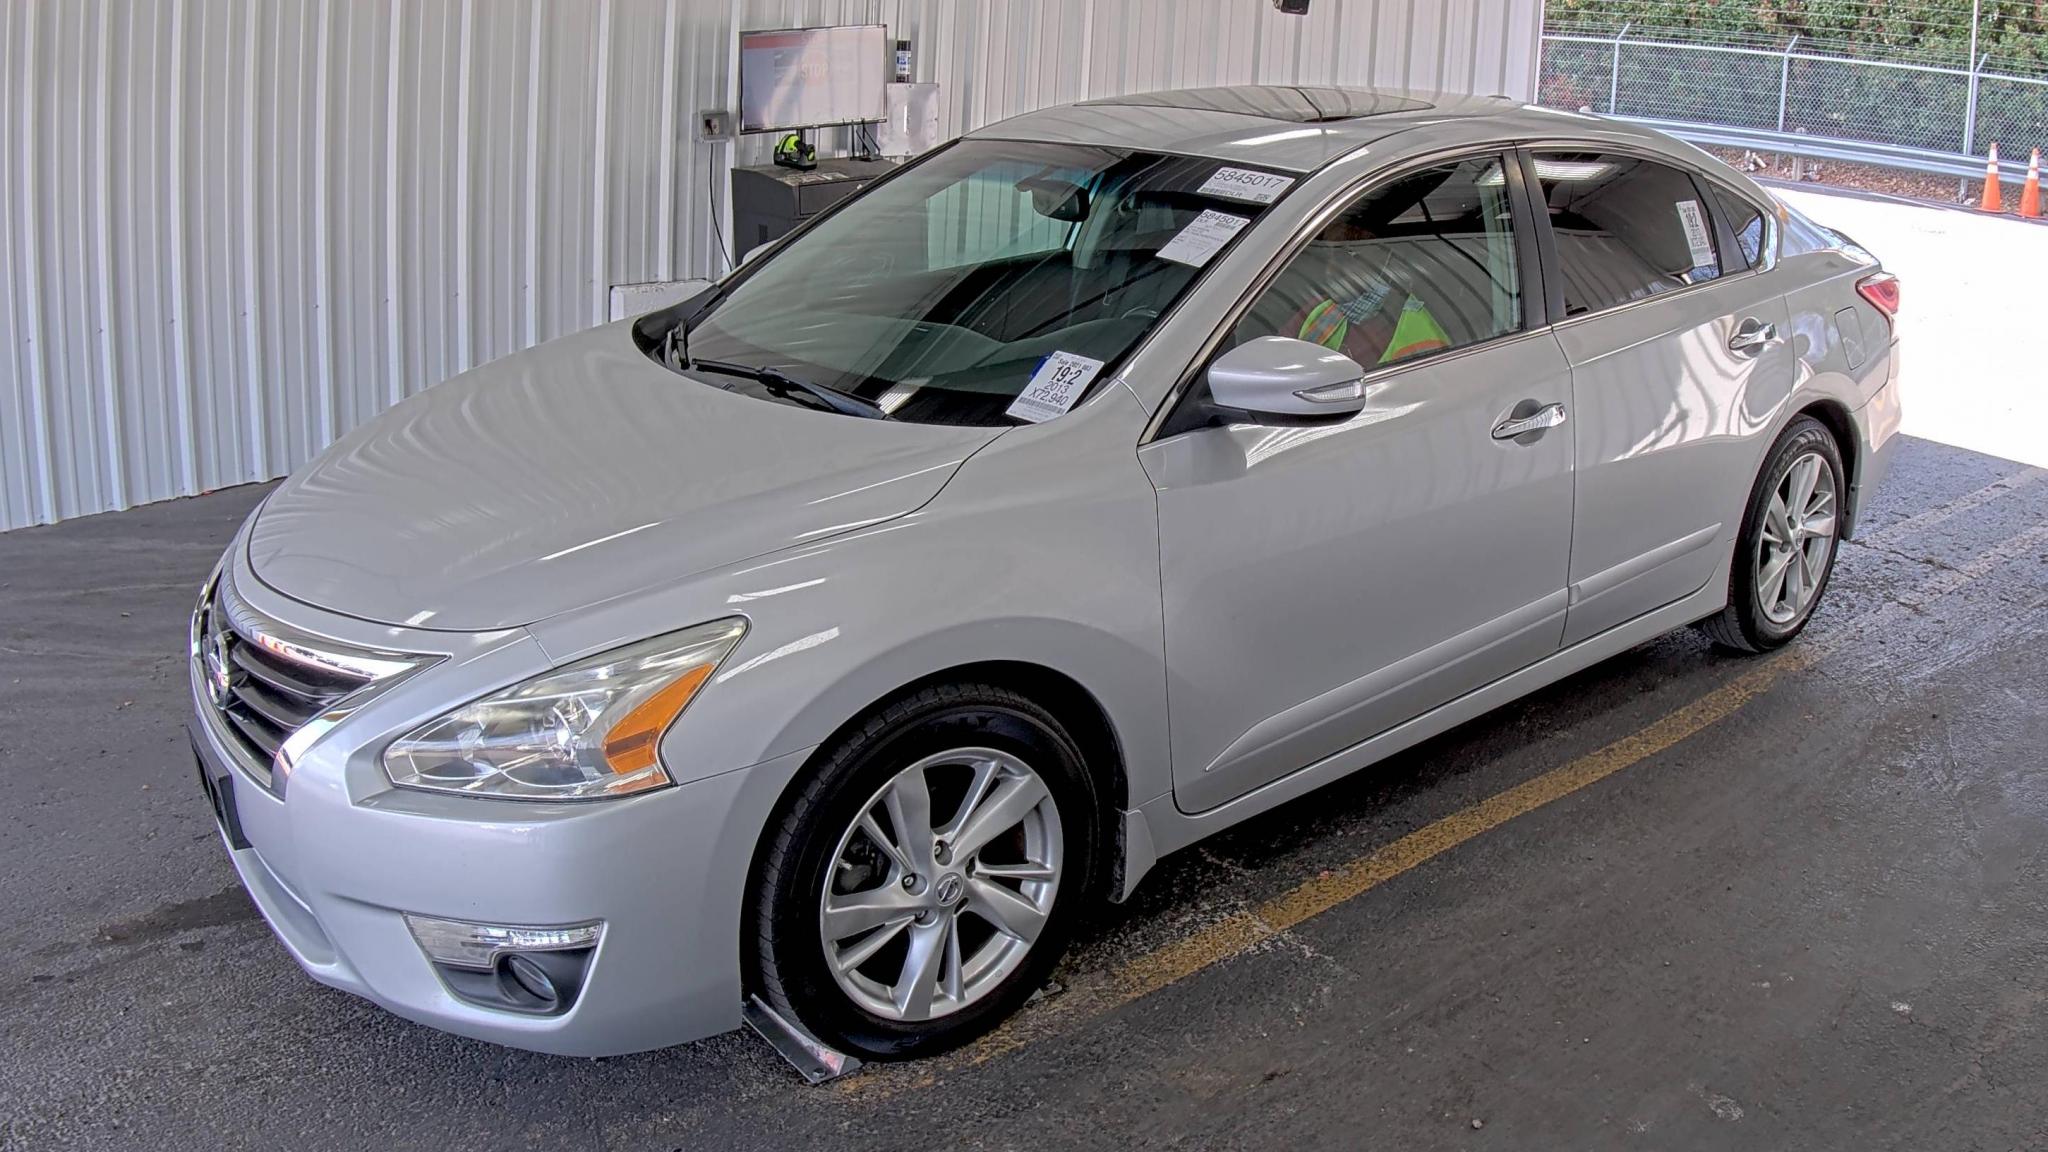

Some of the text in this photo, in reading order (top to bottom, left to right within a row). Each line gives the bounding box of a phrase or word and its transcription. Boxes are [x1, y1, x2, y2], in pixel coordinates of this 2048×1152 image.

[801, 63, 829, 80] STOP
[1214, 170, 1284, 188] 5845017
[1044, 381, 1070, 394] 2013
